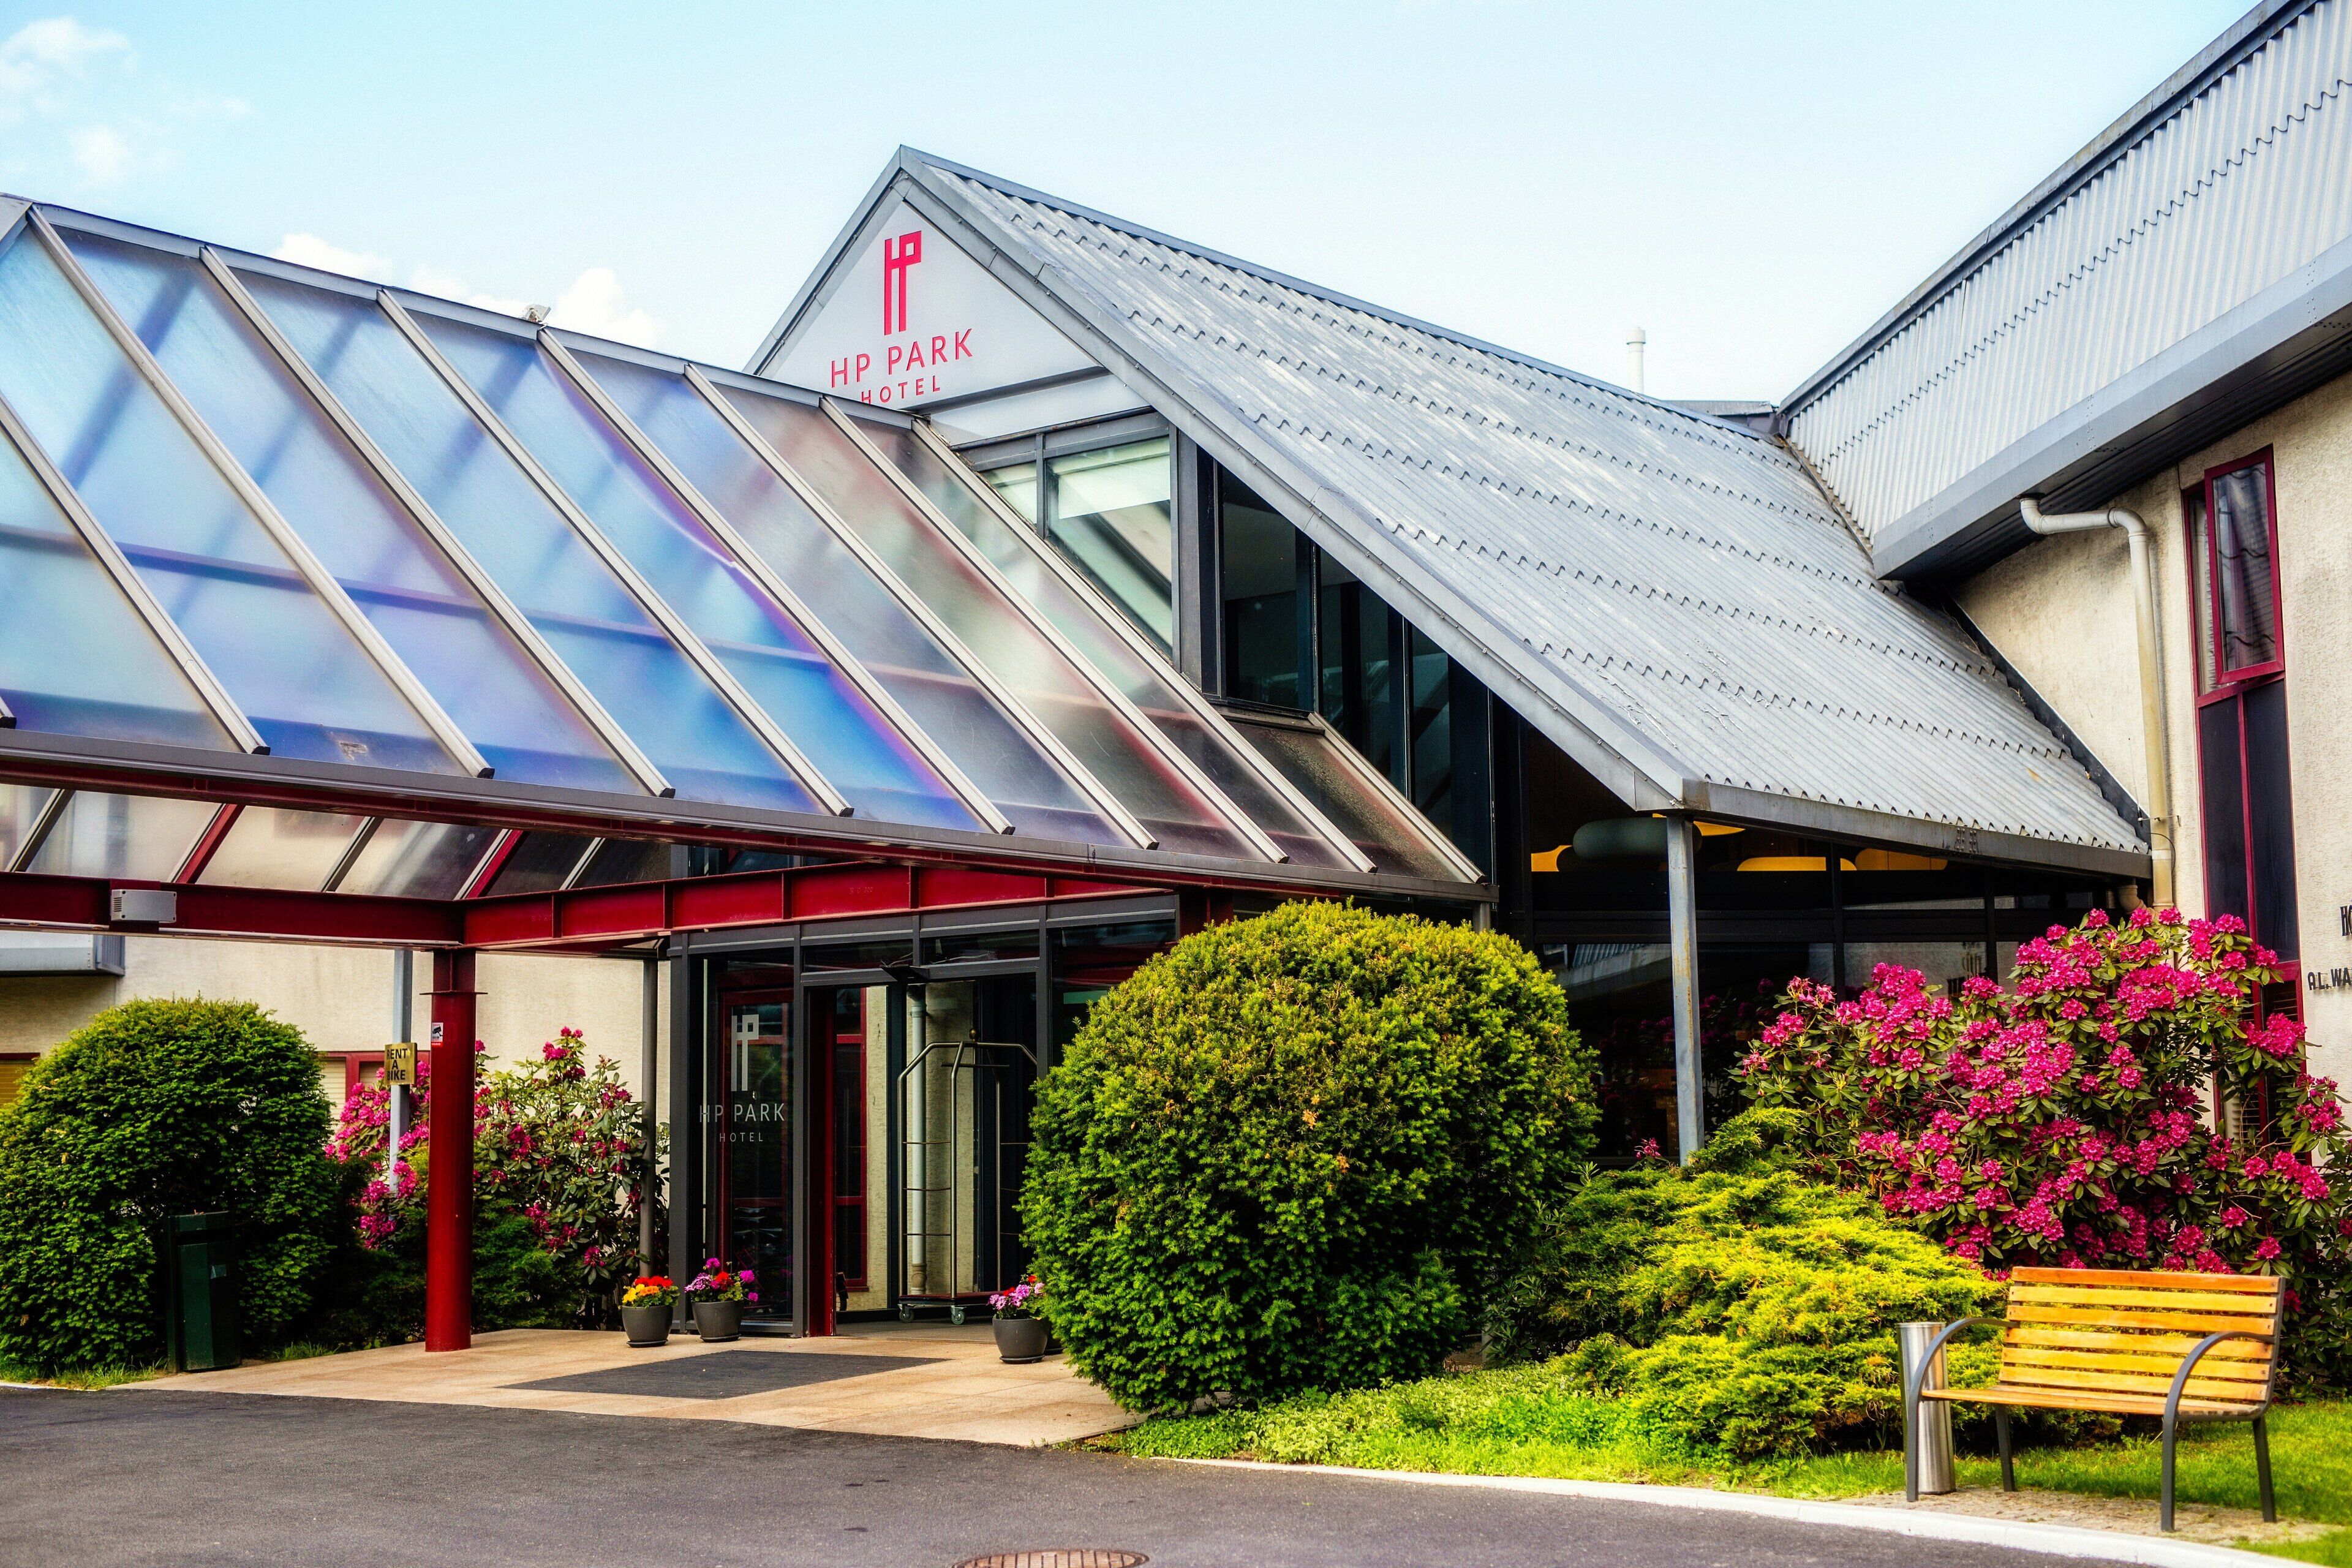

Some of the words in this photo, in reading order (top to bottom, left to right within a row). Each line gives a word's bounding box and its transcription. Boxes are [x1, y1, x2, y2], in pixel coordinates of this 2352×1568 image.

[831, 353, 870, 388] HP
[888, 328, 973, 375] PARK
[861, 375, 940, 405] HOTEL
[386, 1048, 408, 1060] RENT
[391, 1060, 399, 1069] A
[386, 1069, 406, 1081] BIKE
[699, 1104, 724, 1123] HP
[734, 1102, 785, 1122] PARK
[719, 1132, 763, 1142] HOTEL
